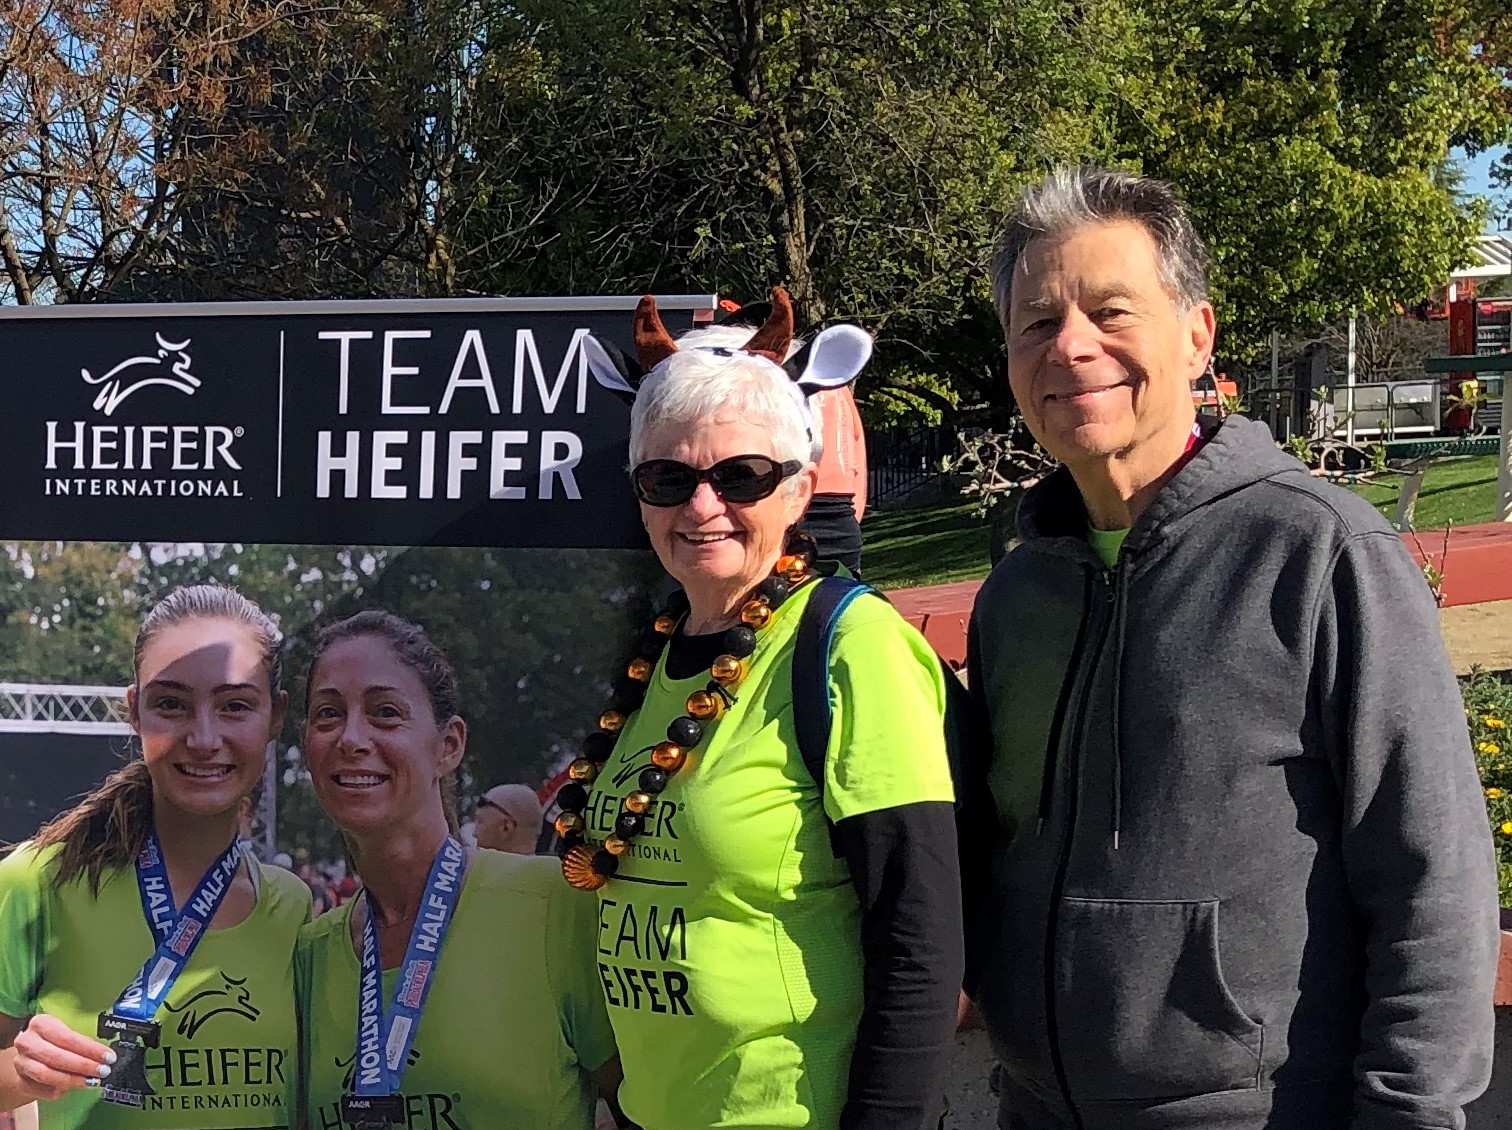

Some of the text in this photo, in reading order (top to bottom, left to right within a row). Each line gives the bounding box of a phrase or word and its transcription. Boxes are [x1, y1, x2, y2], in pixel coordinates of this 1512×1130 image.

[317, 329, 590, 415] TEAM
[44, 478, 244, 498] INTERNATIONAL
[316, 430, 584, 500] HEIFER
[191, 868, 225, 918] HALF
[415, 894, 449, 953] HALF
[598, 899, 687, 961] EAM
[600, 962, 694, 1017] EIFER
[360, 969, 382, 1086] MARATHON
[142, 1093, 286, 1111] INTERNATIONA
